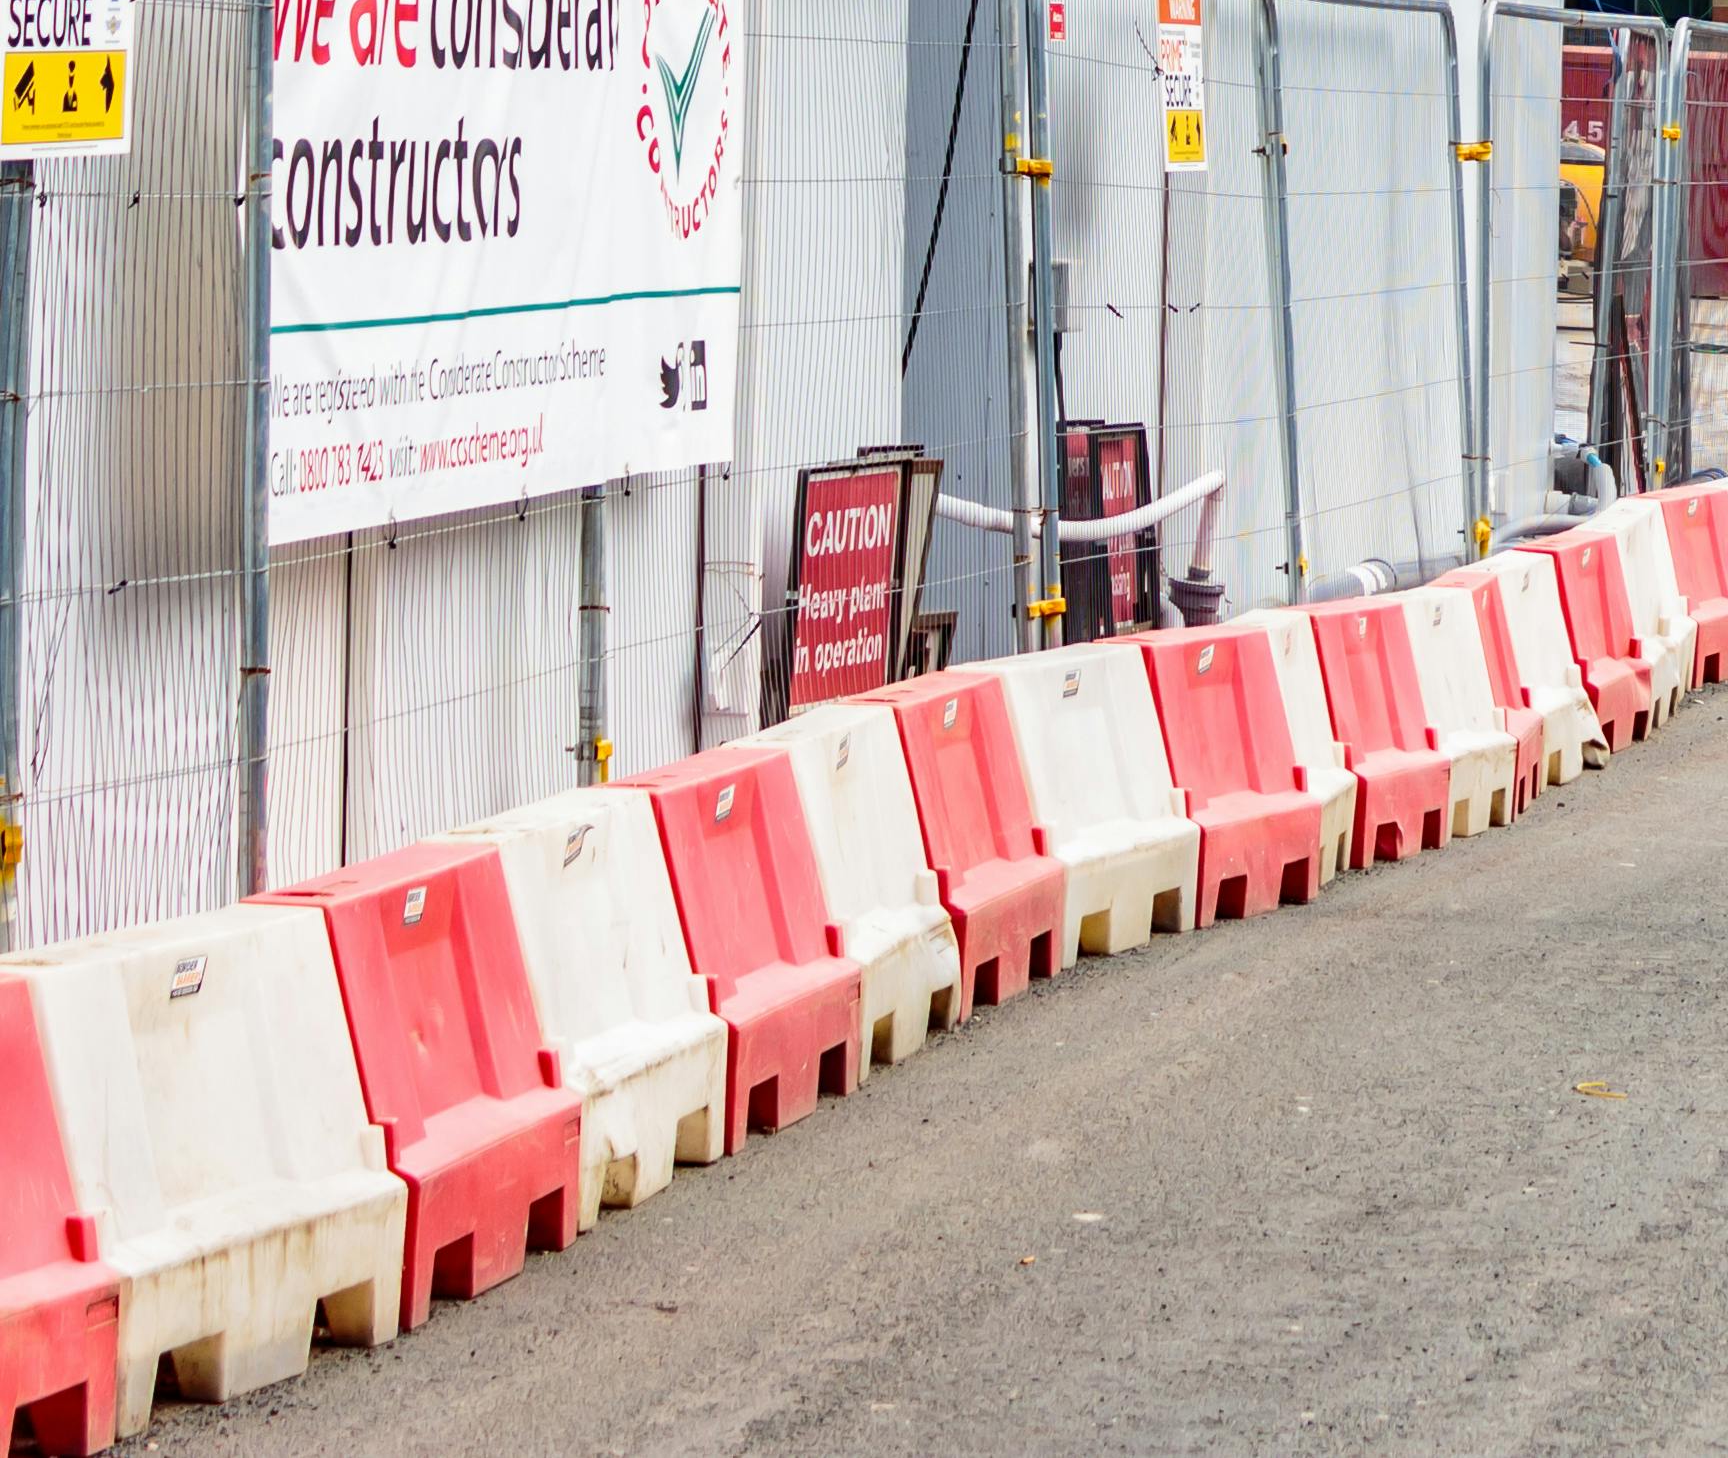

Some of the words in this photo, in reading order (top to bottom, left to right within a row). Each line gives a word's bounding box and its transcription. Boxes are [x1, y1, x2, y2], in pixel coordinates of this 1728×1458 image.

[1165, 74, 1192, 108] SECURE
[272, 115, 522, 250] constructors
[271, 374, 289, 418] We
[292, 382, 312, 417] are
[379, 360, 407, 407] with
[560, 338, 606, 381] Scheme
[271, 448, 297, 497] Call:
[300, 446, 328, 493] 0800
[331, 443, 350, 487] 783
[389, 435, 416, 479] visit:
[806, 502, 892, 558] CAUTION
[797, 583, 847, 624] Heavy
[849, 574, 887, 621] plant
[794, 637, 810, 674] in
[814, 626, 883, 677] operation
